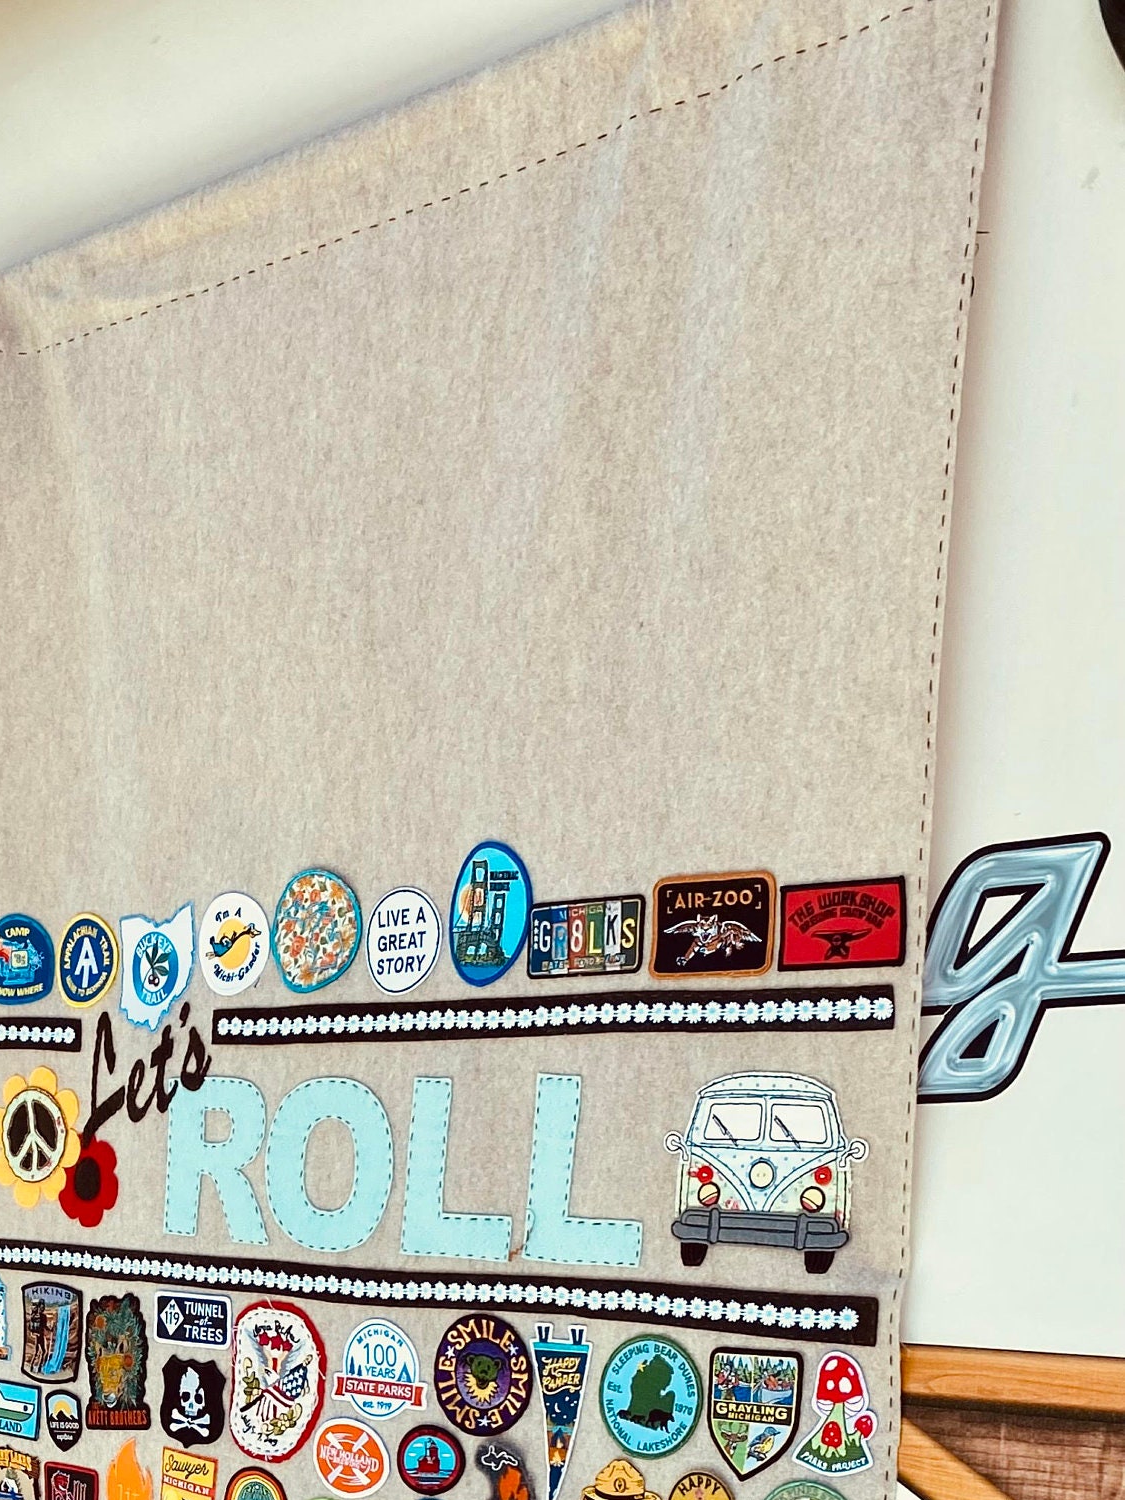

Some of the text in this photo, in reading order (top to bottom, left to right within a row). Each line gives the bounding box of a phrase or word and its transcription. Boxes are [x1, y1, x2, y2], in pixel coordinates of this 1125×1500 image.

[378, 906, 426, 928] LIVE A
[4, 927, 31, 938] CAMP
[377, 931, 426, 952] GREAT
[135, 933, 174, 958] BUCKEYE
[376, 954, 426, 976] STORY
[16, 983, 44, 996] WHERE
[140, 988, 168, 1004] TRAIL
[82, 1001, 212, 1149] Let's
[164, 1071, 643, 1268] ROLL
[32, 1287, 71, 1300] HIKING
[165, 1311, 180, 1326] 119
[184, 1301, 224, 1319] TUNNEL
[183, 1325, 224, 1343] TREES
[356, 1329, 404, 1347] MICHIGAN
[447, 1319, 515, 1353] SMILE
[363, 1343, 397, 1367] 100
[365, 1365, 396, 1379] YEARS
[612, 1344, 695, 1398] SLEEPING BEAR DUNES
[346, 1380, 411, 1398] STATE PARKS
[438, 1356, 480, 1429] SMILE
[488, 1355, 529, 1429] SMILE
[88, 1409, 148, 1426] AVETT BROTHERS
[716, 1402, 788, 1420] GRAYLING
[728, 1412, 775, 1423] MICHIGAN
[50, 1421, 59, 1429] LIFE
[65, 1422, 79, 1430] GOOD
[605, 1399, 687, 1452] NATIONAL LAKESHORE
[165, 1454, 209, 1479] Sawyer
[339, 1450, 380, 1472] HOLLAND
[800, 1451, 866, 1471] PARKS PROJECT
[163, 1475, 209, 1495] MICHIGAN
[678, 1475, 721, 1496] HAPPY
